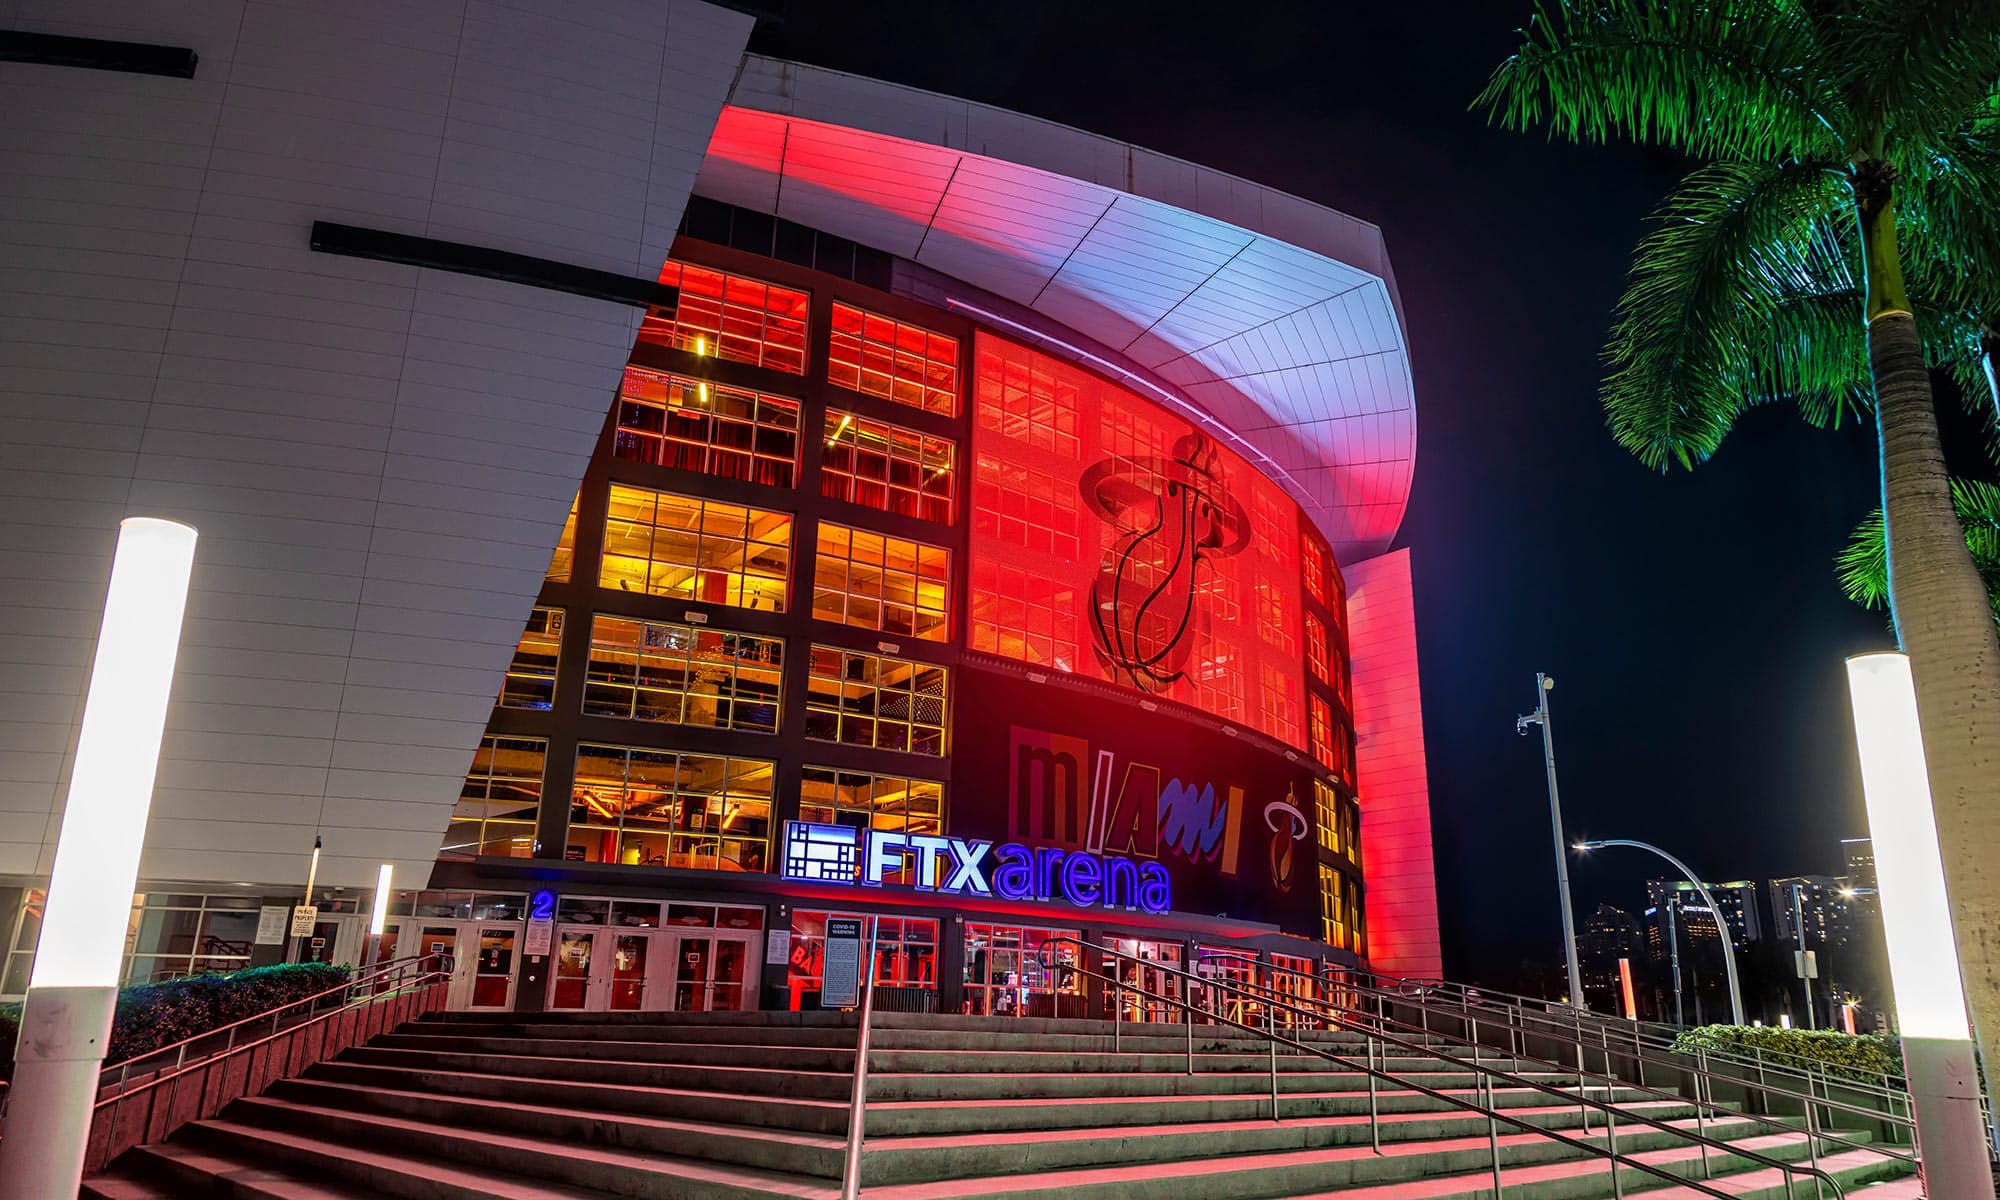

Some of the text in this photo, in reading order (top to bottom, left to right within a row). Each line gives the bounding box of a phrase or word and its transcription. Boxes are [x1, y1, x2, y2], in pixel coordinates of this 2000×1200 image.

[862, 827, 1172, 915] FTX arena
[531, 891, 553, 919] 2
